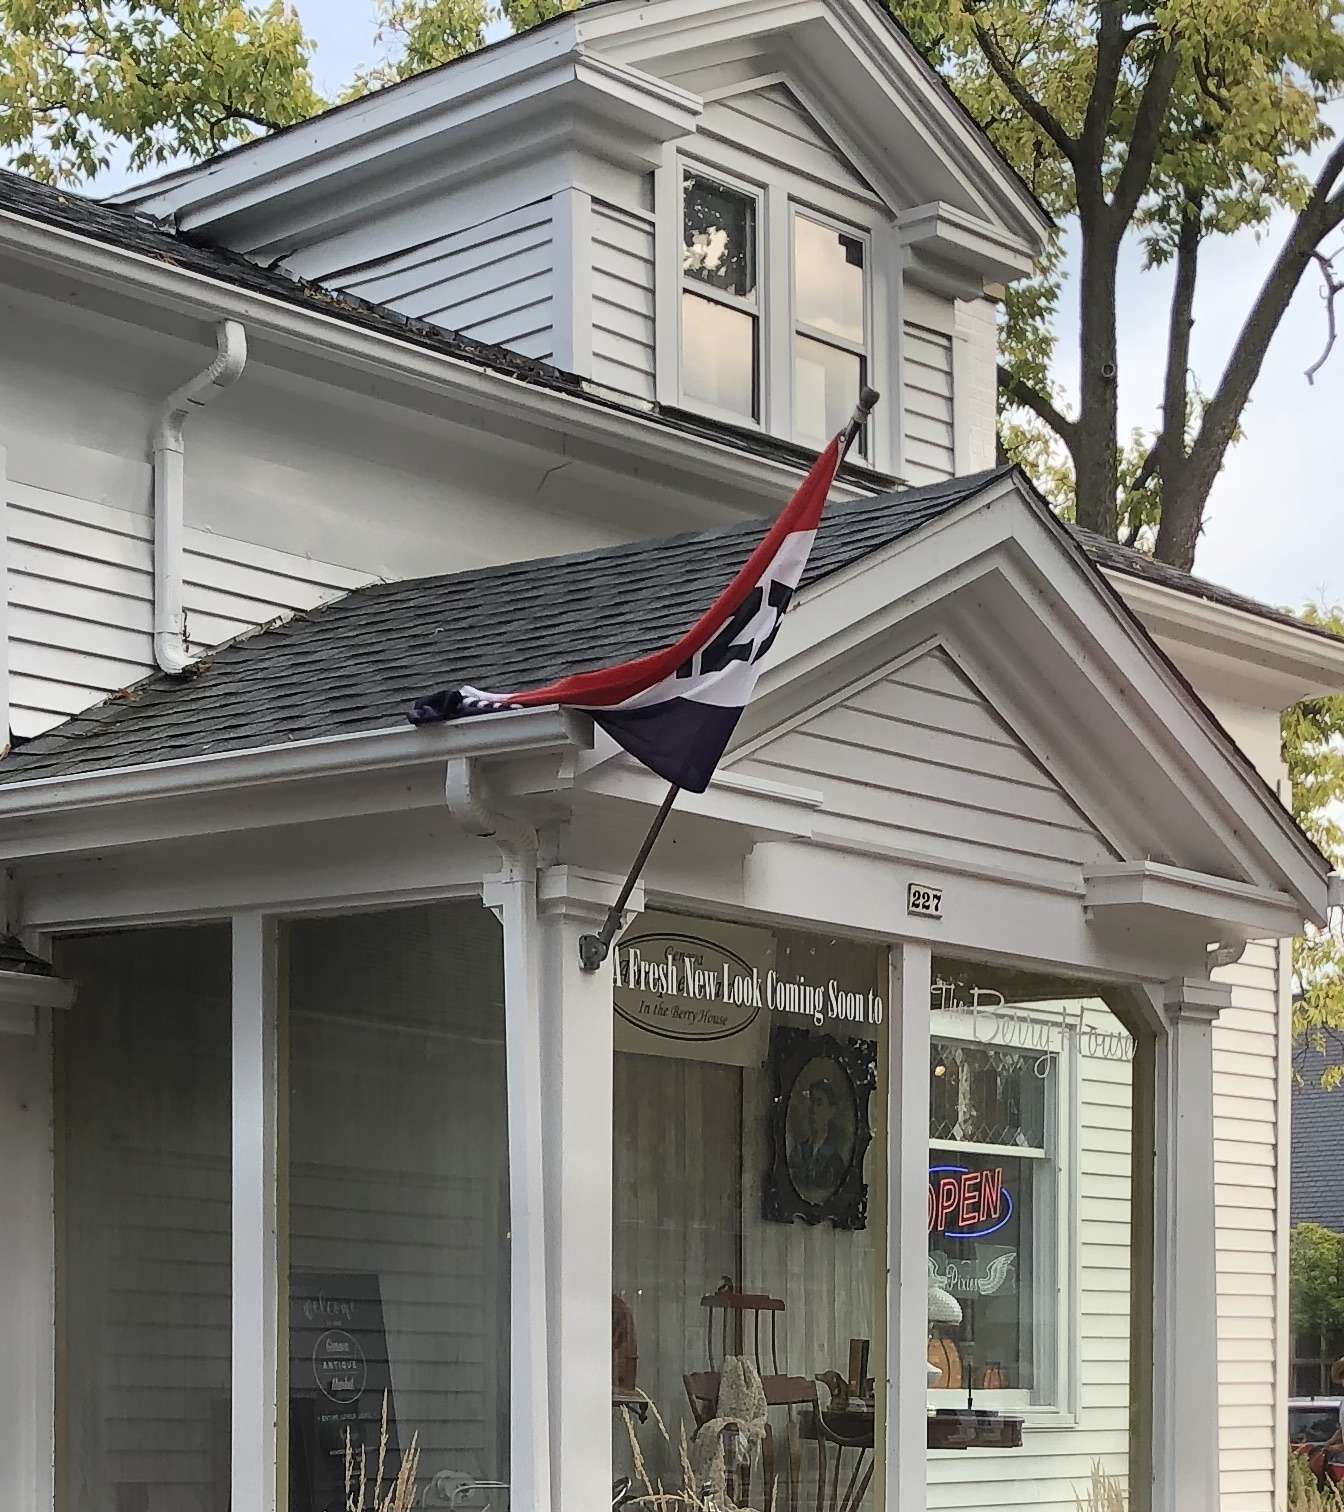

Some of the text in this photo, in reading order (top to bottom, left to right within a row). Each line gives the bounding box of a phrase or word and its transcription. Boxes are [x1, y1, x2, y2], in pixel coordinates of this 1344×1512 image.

[911, 889, 942, 912] 227
[629, 947, 678, 996] Fresh
[683, 956, 718, 1002] New
[722, 962, 763, 1008] Look
[766, 969, 825, 1027] Coming
[828, 979, 864, 1023] Soon
[867, 987, 883, 1025] to
[638, 1000, 729, 1026] In the Berry House
[970, 986, 1058, 1078] Berry
